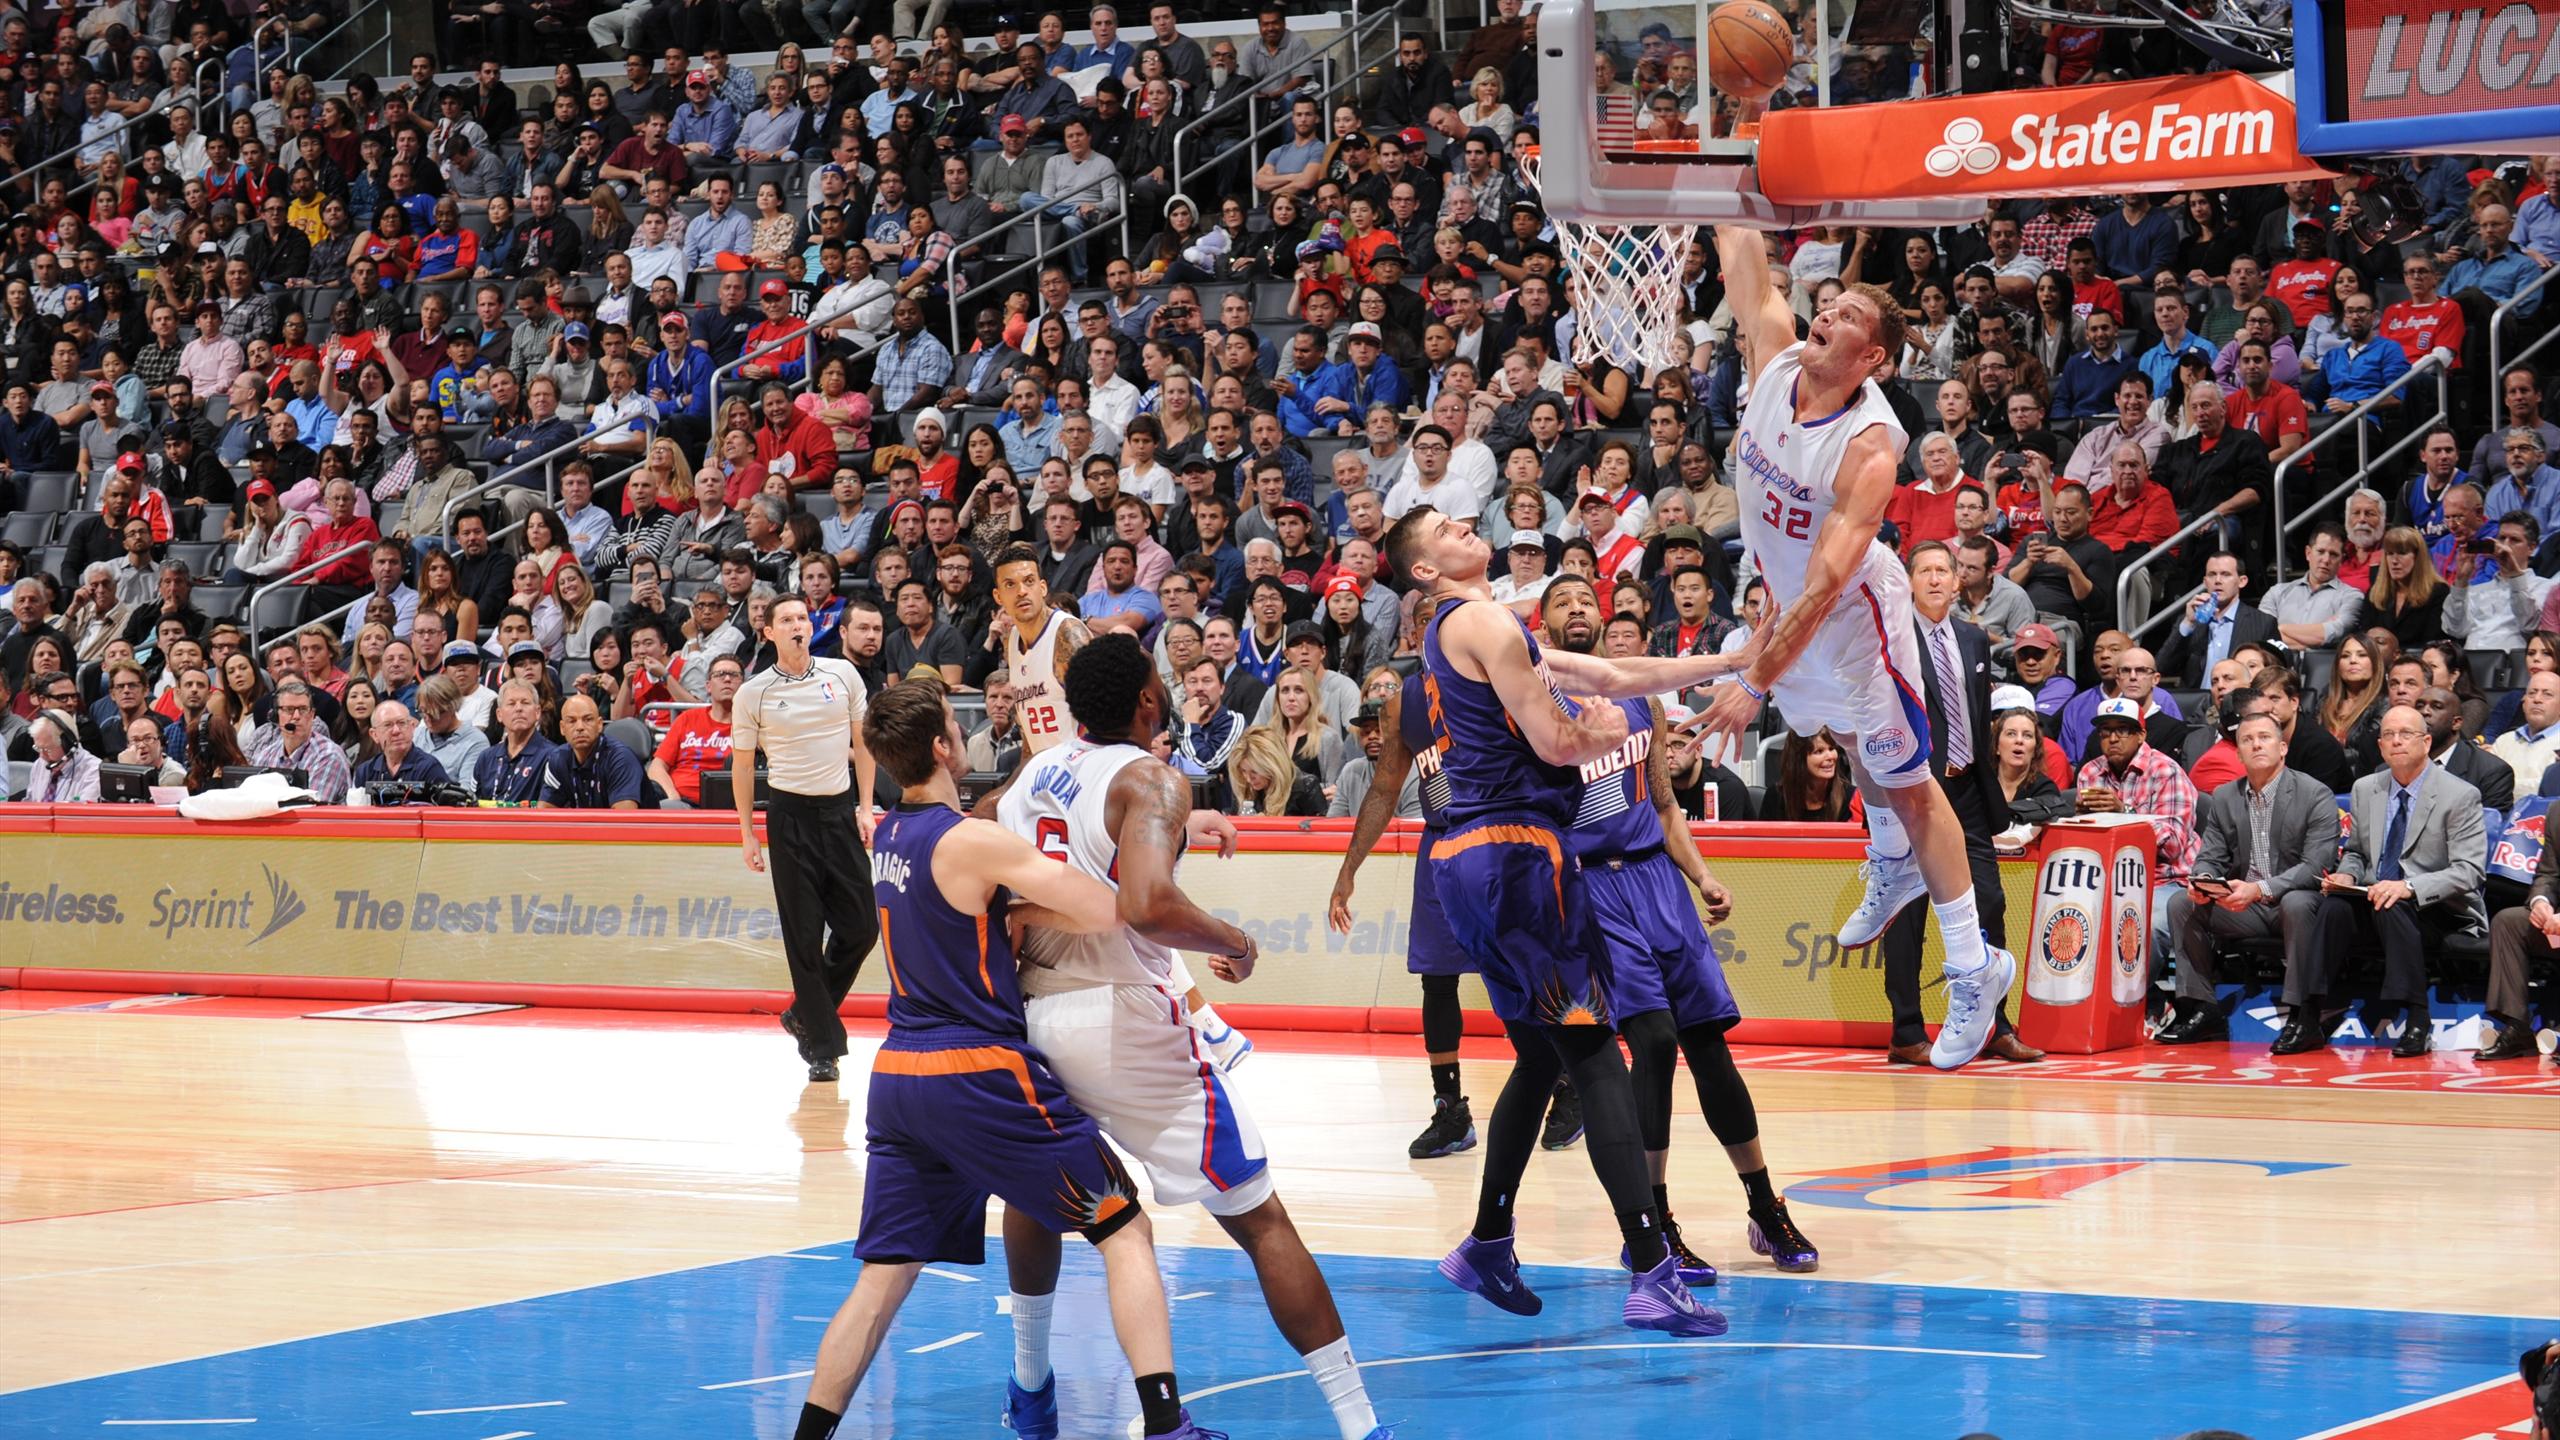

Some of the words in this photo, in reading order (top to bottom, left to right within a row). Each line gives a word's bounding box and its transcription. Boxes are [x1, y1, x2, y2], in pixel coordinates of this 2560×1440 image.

[1739, 430, 1816, 502] Clippers
[1762, 490, 1813, 541] 32
[680, 731, 703, 749] Los
[1027, 705, 1059, 735] 22
[1580, 729, 1654, 784] HOENIX
[1031, 765, 1082, 811] JORDAN
[1036, 816, 1069, 863] 6
[2043, 858, 2101, 897] Lite
[2114, 858, 2144, 897] Lite
[0, 881, 124, 924] ireless.
[149, 888, 253, 939] Sprint
[334, 890, 404, 931] The
[410, 892, 501, 934] Best
[511, 894, 622, 936] Value
[627, 894, 668, 937] in
[2063, 908, 2089, 945] PILSNER
[2048, 957, 2081, 972] BEER
